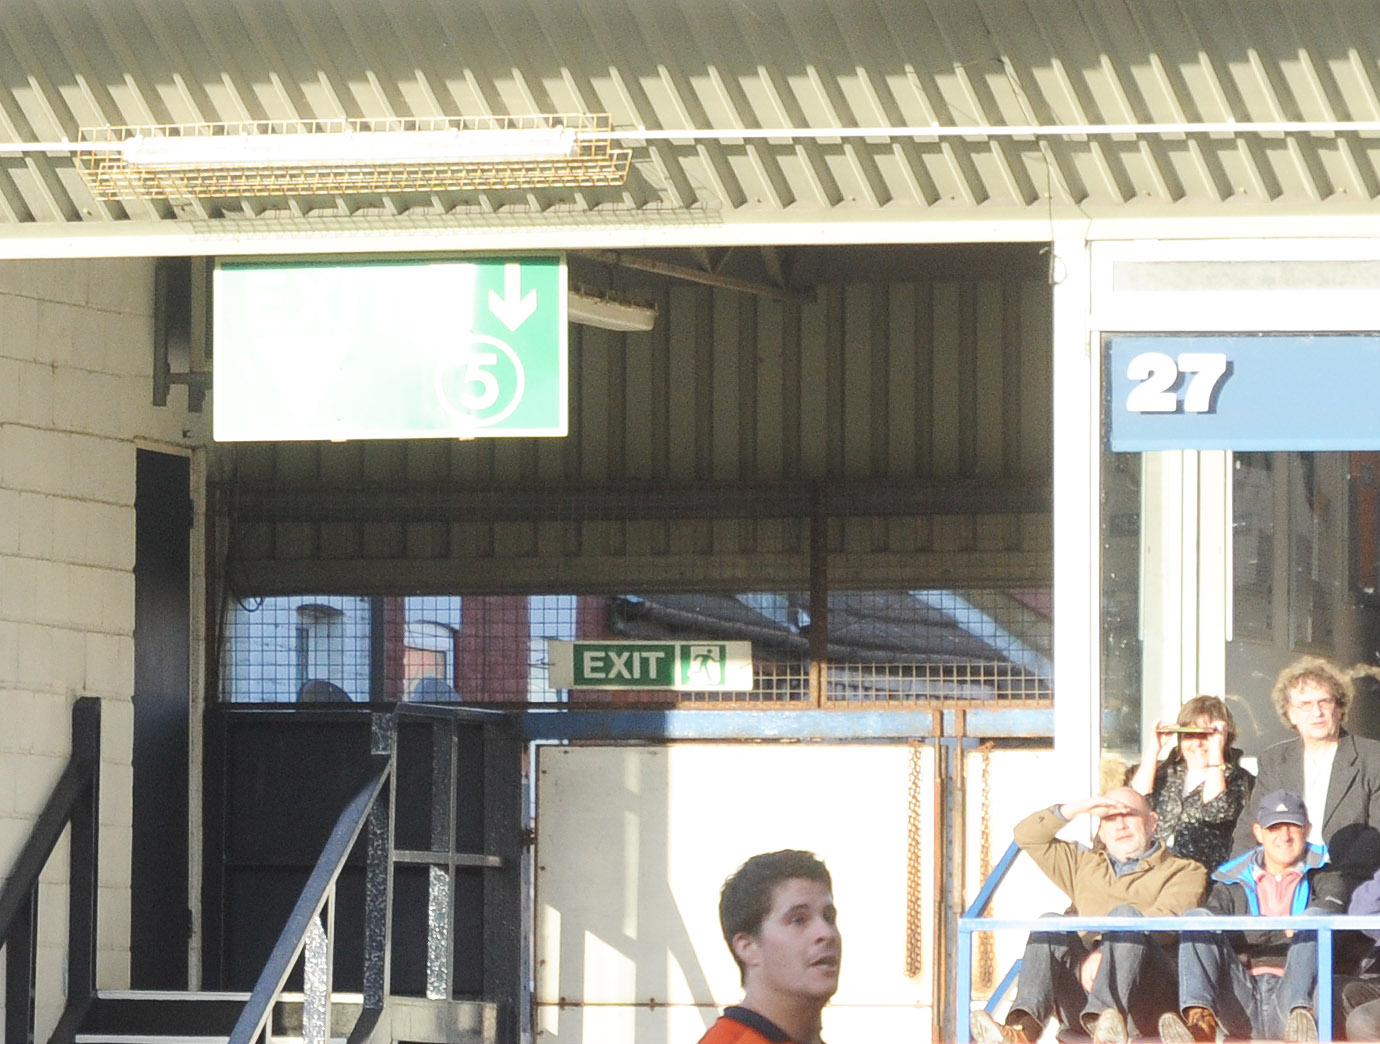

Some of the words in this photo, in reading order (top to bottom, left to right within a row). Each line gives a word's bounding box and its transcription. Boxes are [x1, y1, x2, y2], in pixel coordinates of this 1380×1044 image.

[460, 353, 499, 410] 5
[1126, 352, 1230, 413] 27
[583, 651, 665, 679] EXIT
